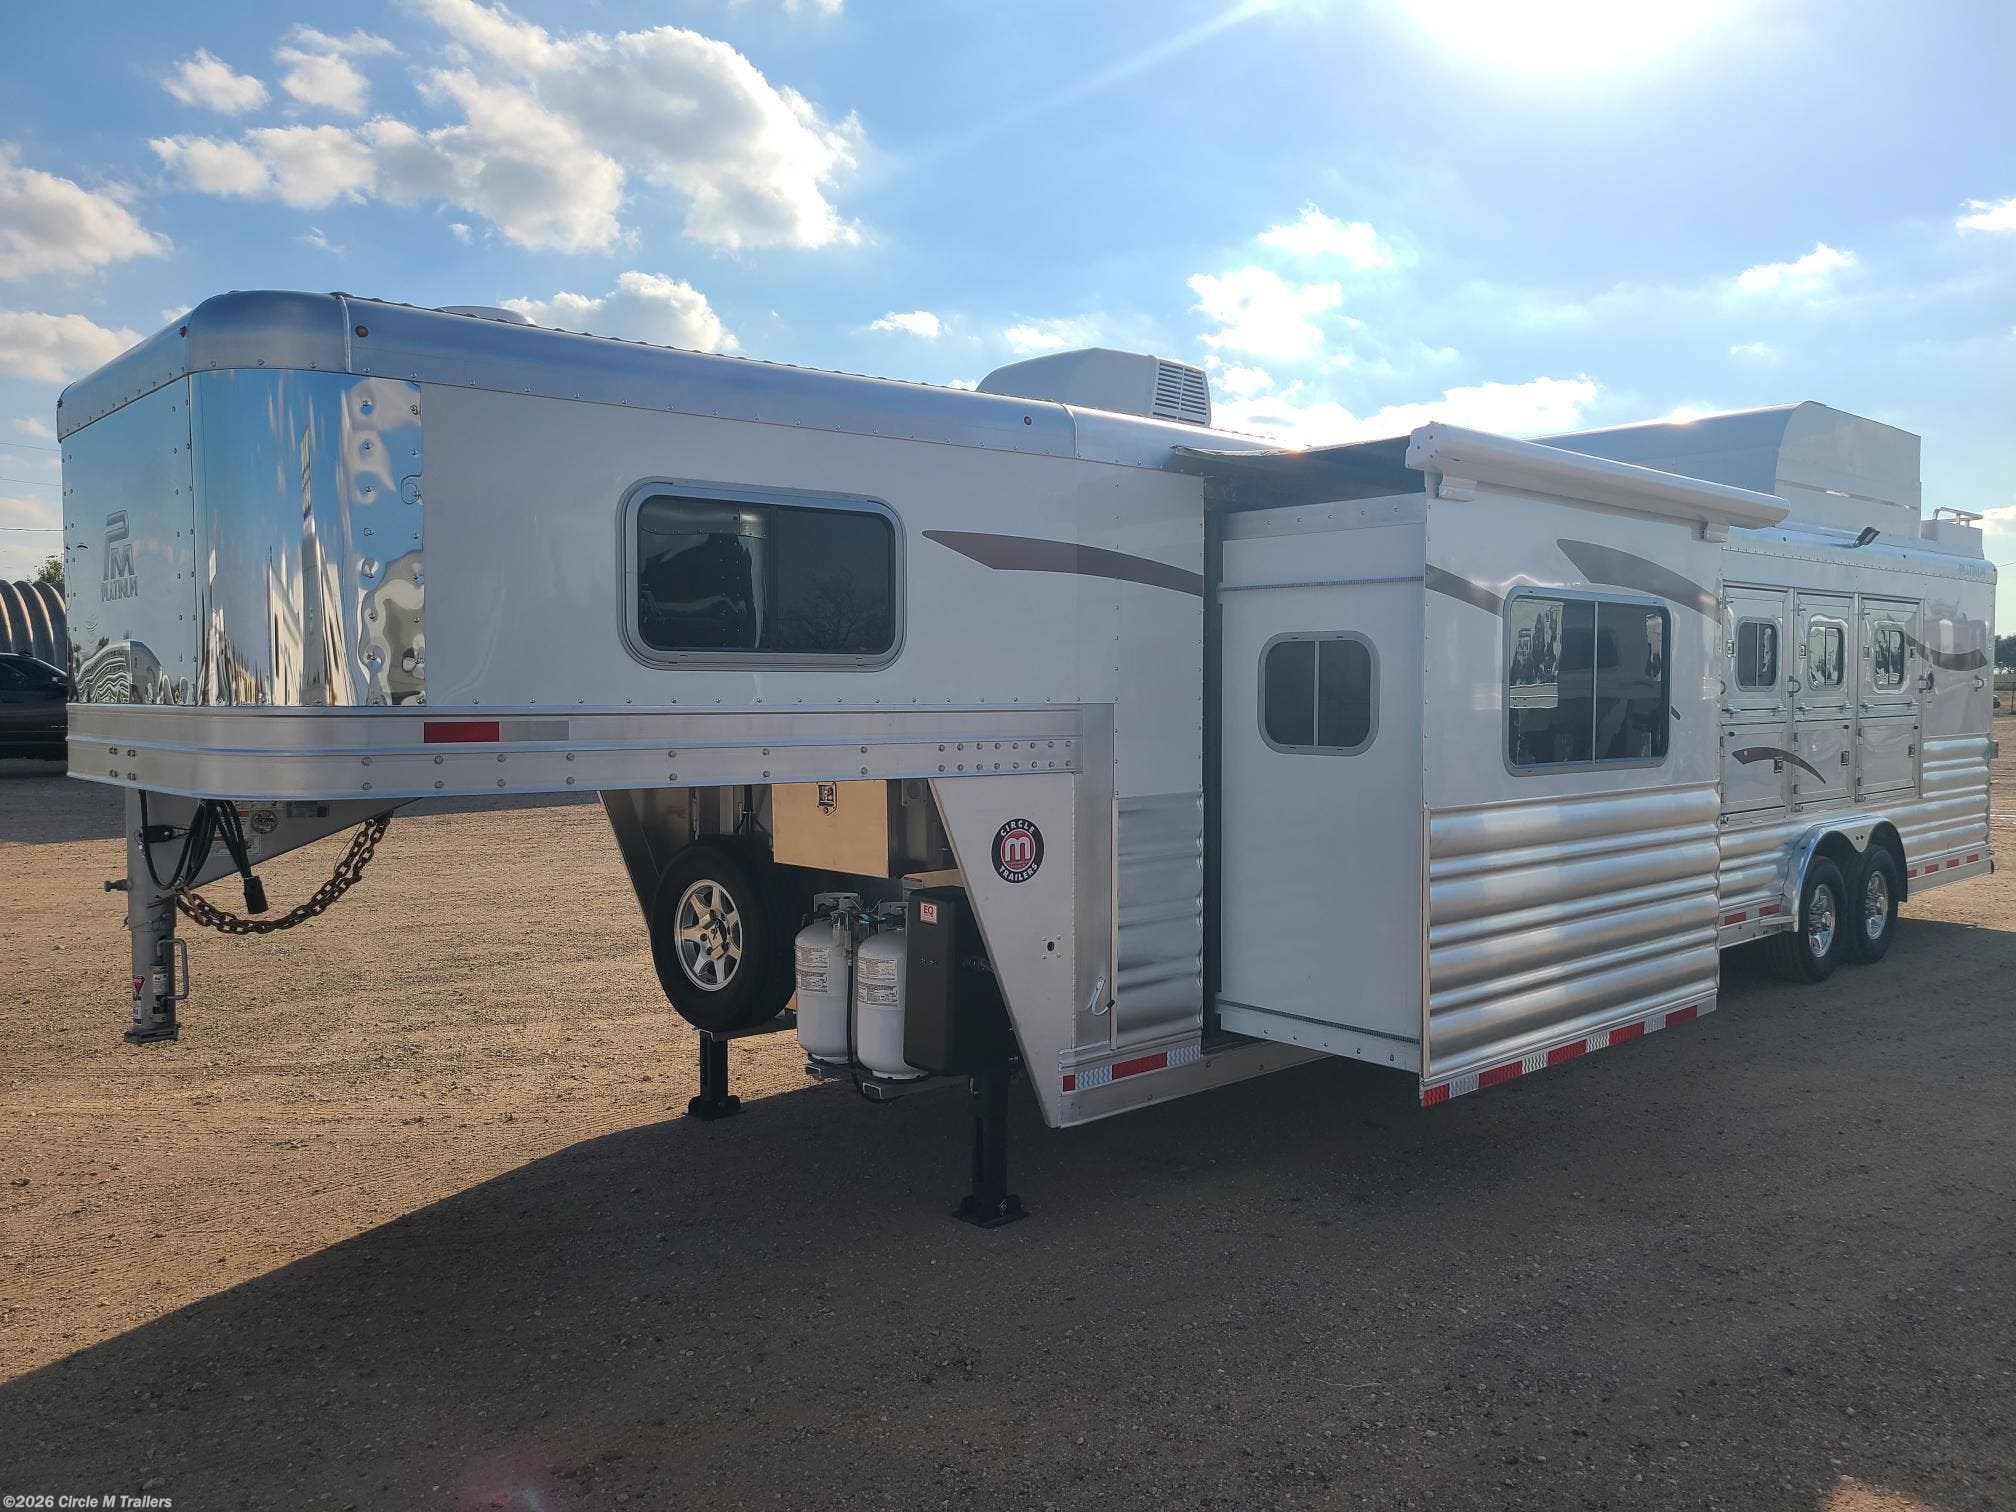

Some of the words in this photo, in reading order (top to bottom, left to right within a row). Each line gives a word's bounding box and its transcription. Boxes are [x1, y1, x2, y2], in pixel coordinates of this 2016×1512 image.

[1001, 820, 1035, 836] CIRCLE
[1000, 863, 1037, 881] TRAILERS
[923, 905, 934, 915] EQ
